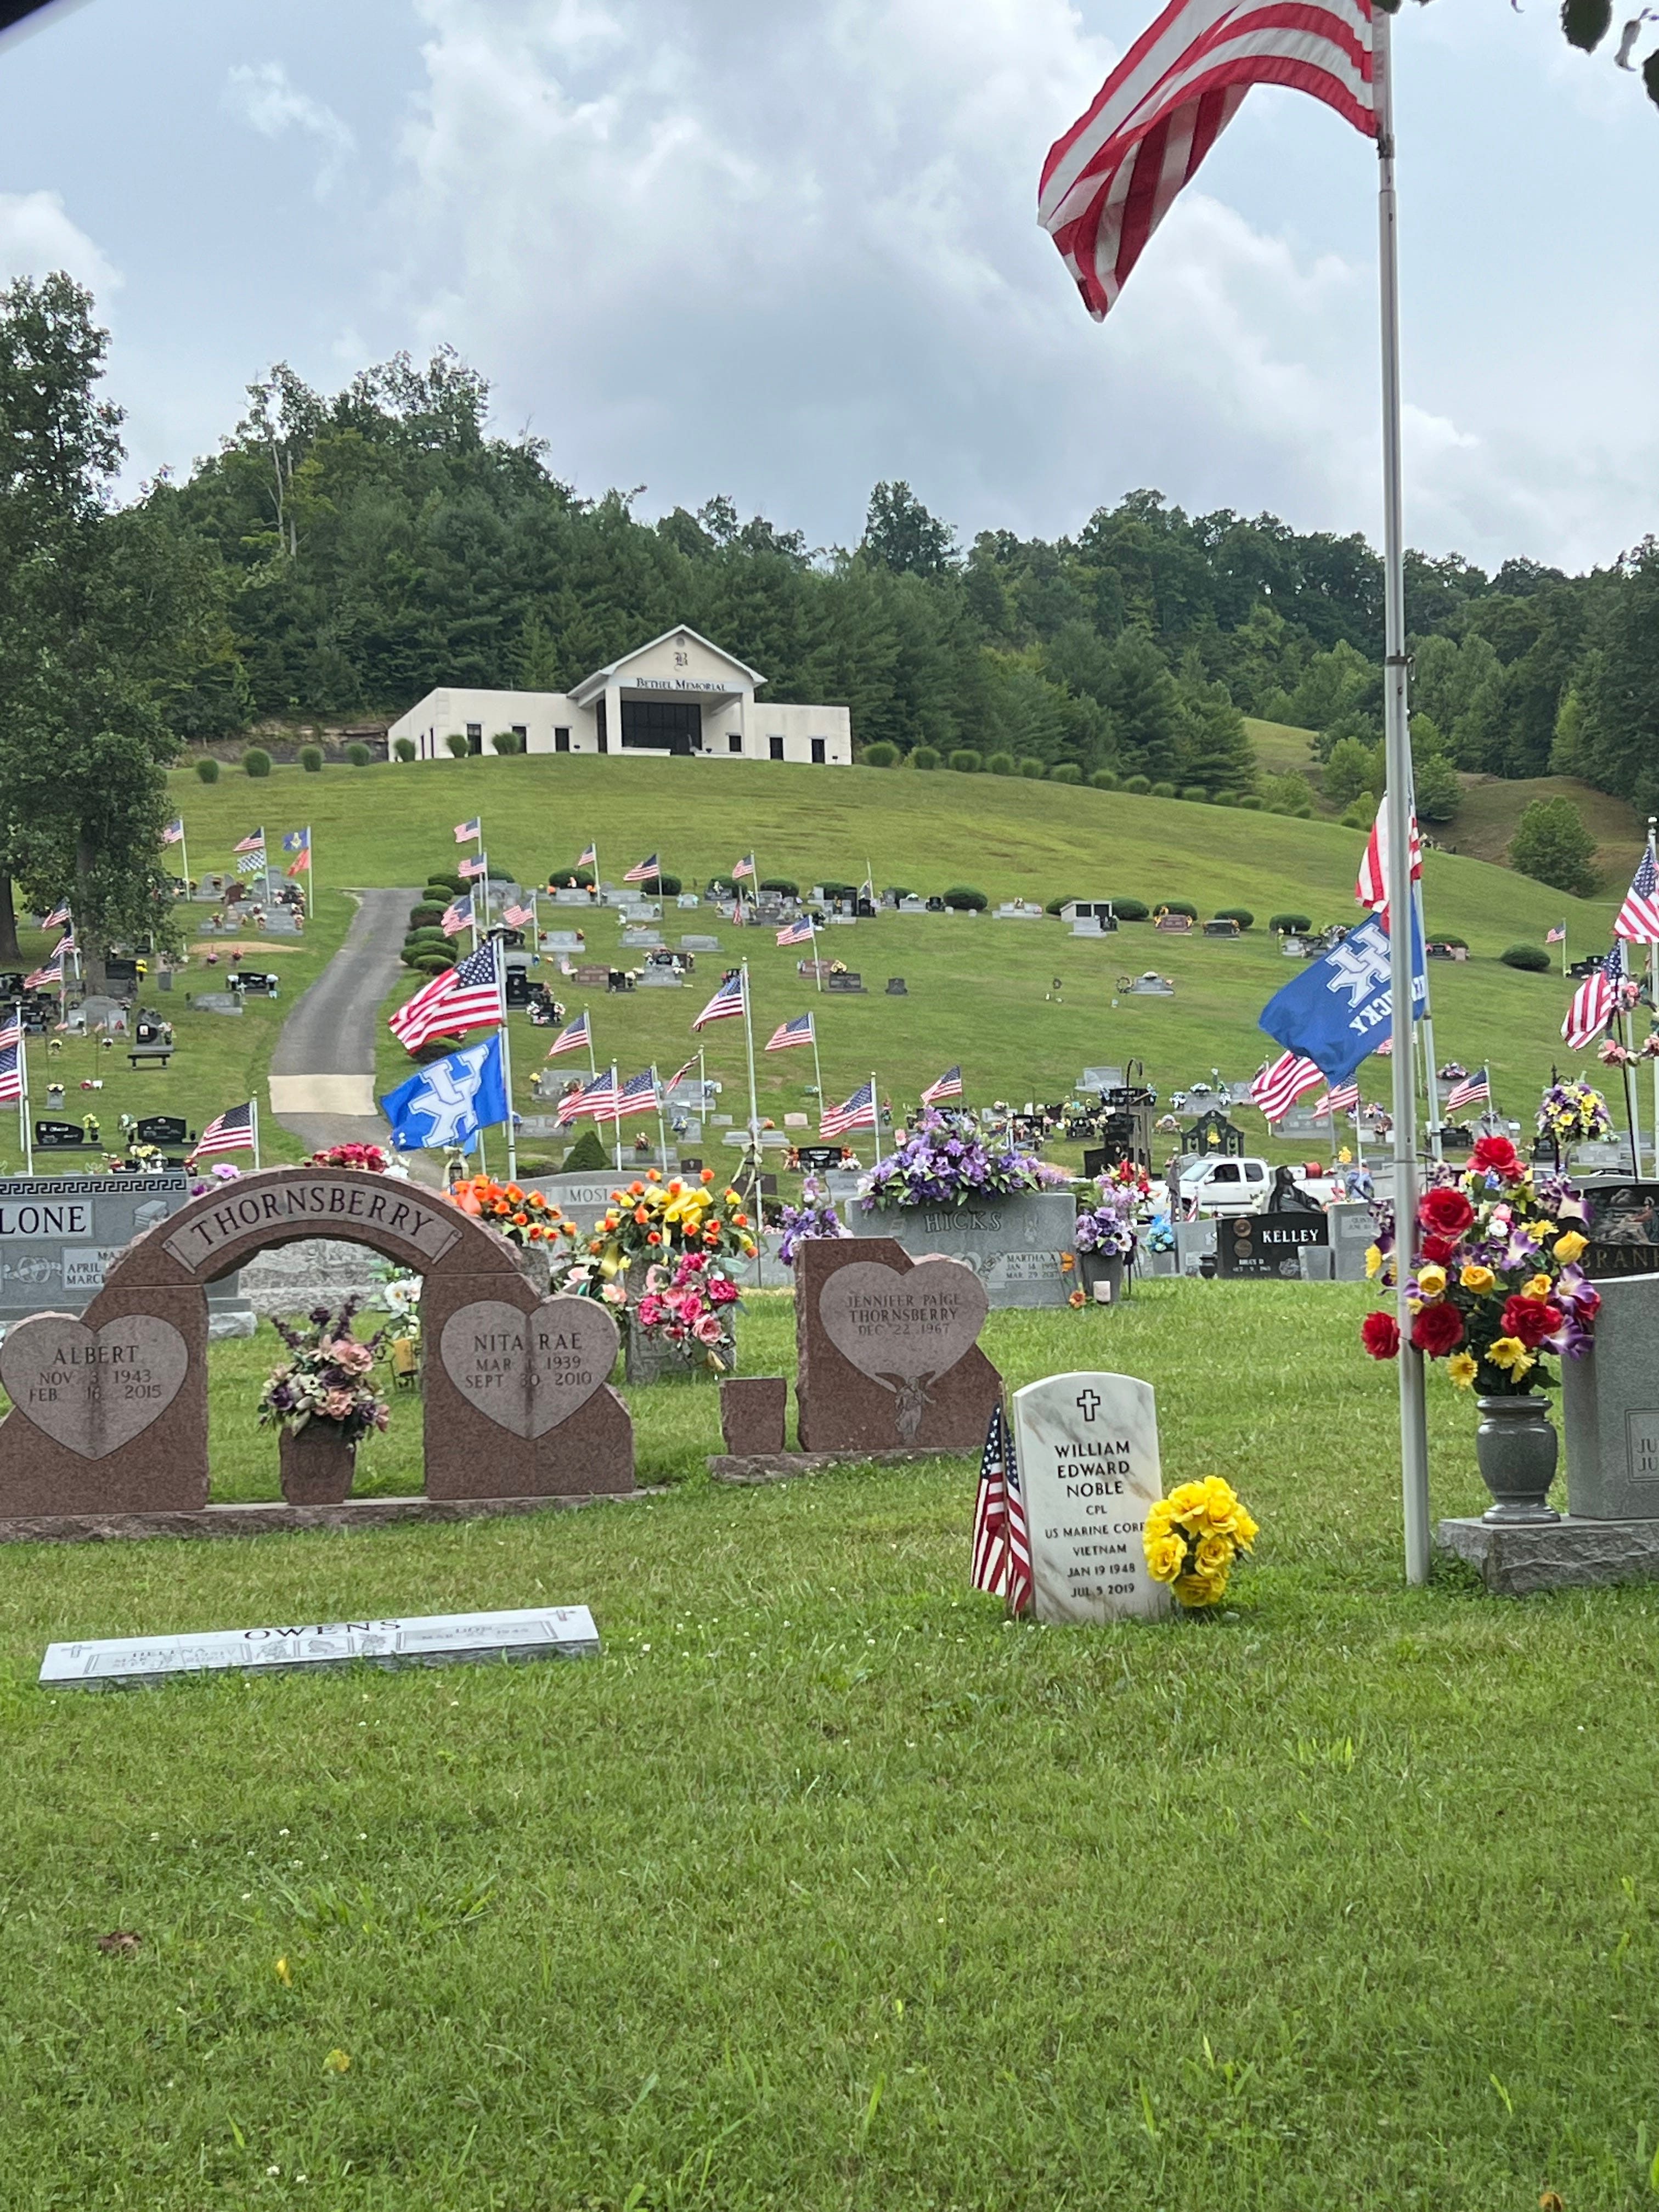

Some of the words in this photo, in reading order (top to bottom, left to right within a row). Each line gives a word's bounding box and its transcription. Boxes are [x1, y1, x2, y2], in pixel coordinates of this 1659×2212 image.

[637, 678, 671, 690] BETHEL
[675, 680, 727, 691] MEMORIAL
[570, 1187, 629, 1203] MOSL
[190, 1187, 435, 1247] THORNSBERRY
[924, 1211, 1002, 1233] HICKS
[1263, 1229, 1319, 1243] KELLEY
[67, 1263, 101, 1273] APRIL
[845, 1294, 914, 1308] JENNIFER
[923, 1292, 961, 1306] PAIGE
[849, 1308, 958, 1323] THORNSBERRY
[859, 1324, 884, 1336] DEC
[894, 1324, 911, 1335] 22
[921, 1323, 950, 1334] 1967
[474, 1334, 523, 1352] NITA
[539, 1332, 583, 1350] RAE
[52, 1345, 139, 1365] ALBERT
[476, 1358, 512, 1372] MAR
[548, 1356, 581, 1369] 1939
[39, 1372, 73, 1385] NOV
[90, 1371, 100, 1385] 3
[114, 1370, 151, 1384] 1943
[465, 1374, 503, 1389] SEPT
[554, 1372, 592, 1386] 2010
[29, 1387, 58, 1402] FEB
[125, 1385, 162, 1400] 2015
[1054, 1440, 1130, 1459] WILLIAM
[1057, 1460, 1130, 1479] EDWARD
[1067, 1481, 1124, 1498] NOBLE
[1086, 1505, 1108, 1516] CPL
[1045, 1528, 1058, 1539] US
[1063, 1525, 1109, 1537] MARINE
[1114, 1522, 1145, 1534] CORP
[1073, 1544, 1127, 1557] VIETNAM
[1067, 1567, 1091, 1578] JAN
[1094, 1565, 1105, 1576] 19
[1109, 1563, 1136, 1575] 1948
[1070, 1587, 1090, 1598] JUL
[1108, 1583, 1135, 1595] 2019
[244, 1620, 401, 1640] OWENS
